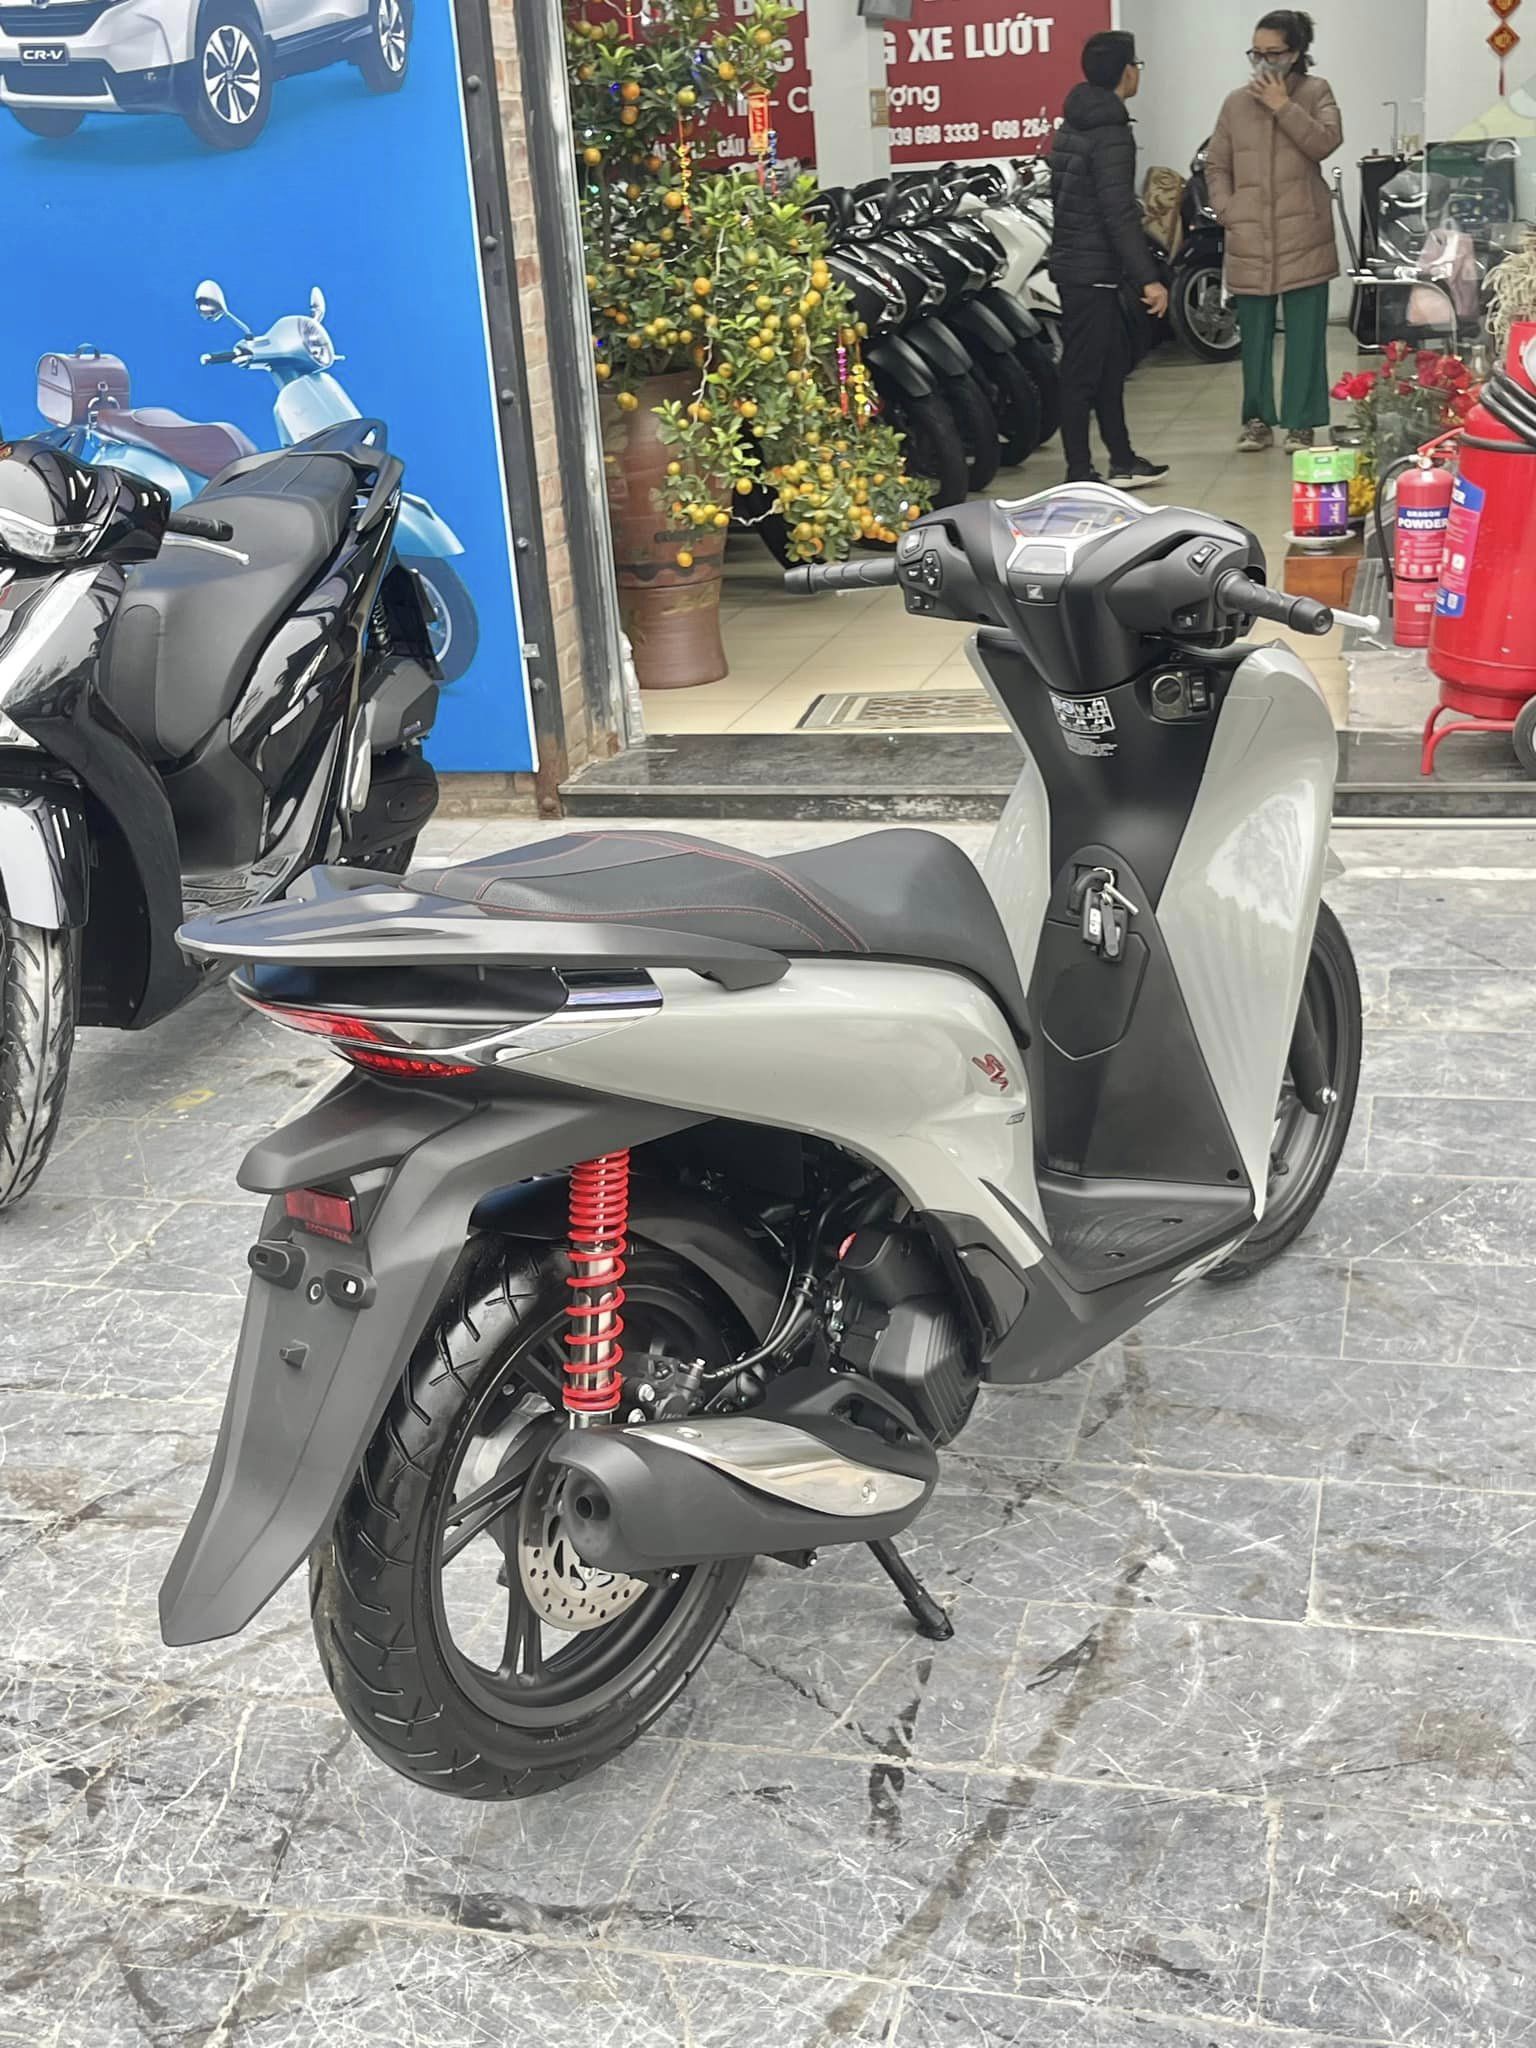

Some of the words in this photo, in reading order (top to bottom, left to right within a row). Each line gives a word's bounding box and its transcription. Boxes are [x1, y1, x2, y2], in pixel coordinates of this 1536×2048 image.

[907, 26, 954, 63] XE
[964, 12, 1055, 59] LƯỚT
[23, 49, 64, 60] CR-V
[943, 122, 980, 143] 3333
